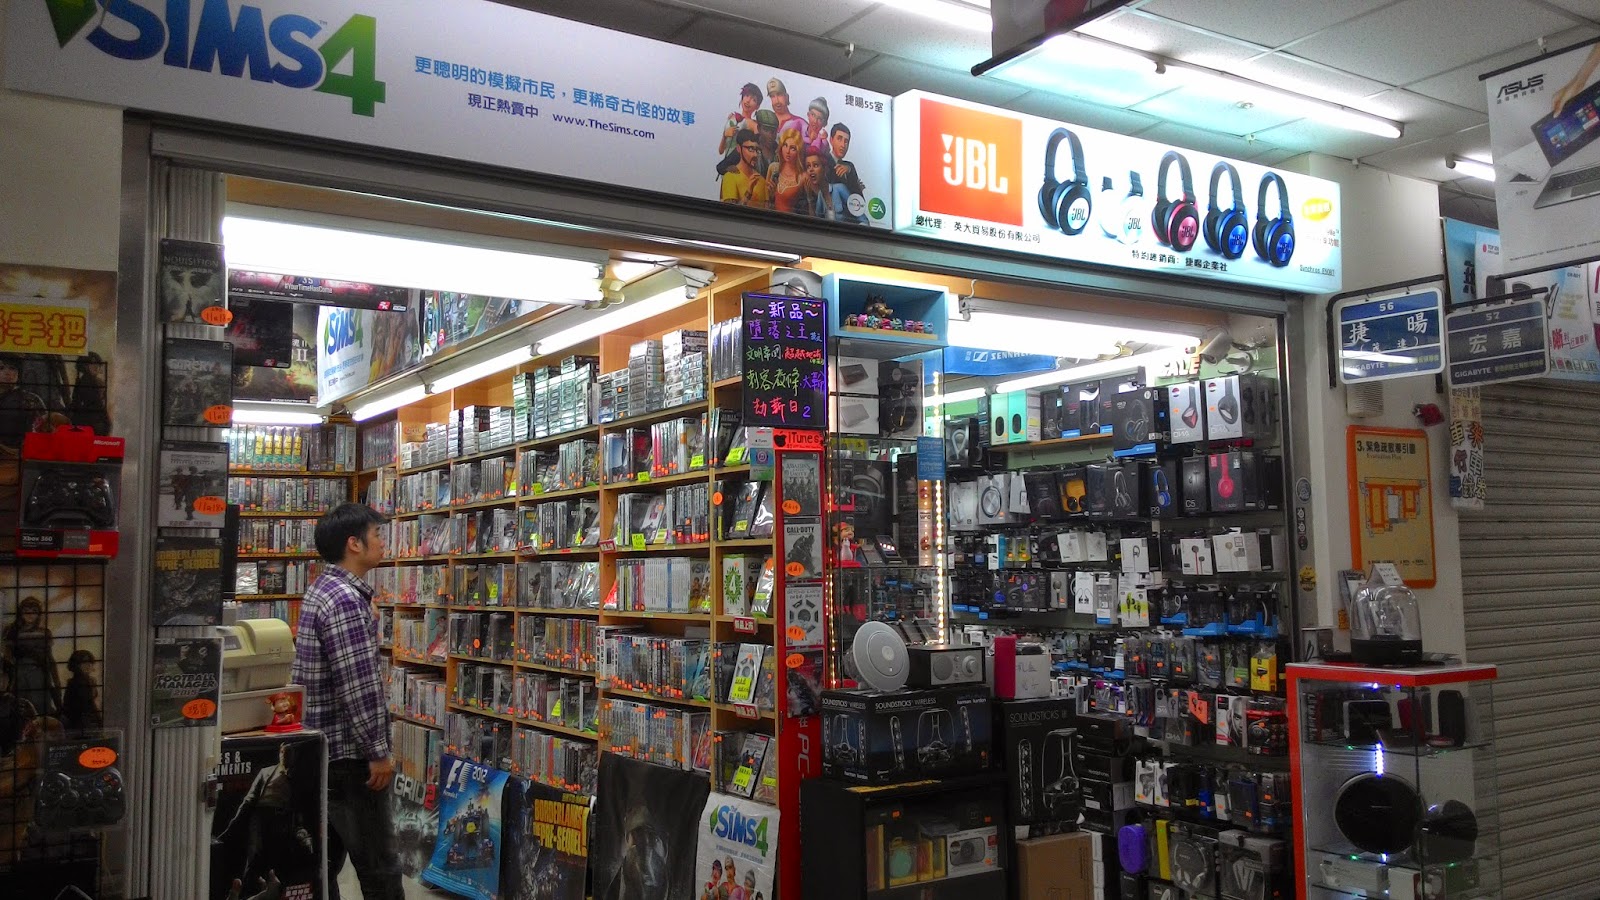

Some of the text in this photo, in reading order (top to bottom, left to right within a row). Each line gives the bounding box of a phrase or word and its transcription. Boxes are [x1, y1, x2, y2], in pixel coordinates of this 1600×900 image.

[86, 0, 386, 118] SIMS 4
[1497, 74, 1544, 99] ASUS
[552, 112, 656, 140] www.TheSims.com
[941, 132, 1009, 195] JBL
[1071, 206, 1086, 222] JBL
[1128, 217, 1142, 230] JBL
[1181, 226, 1195, 239] JBL
[1379, 301, 1395, 312] 56
[1485, 311, 1500, 321] 57
[0, 309, 87, 348] 手把
[1468, 327, 1522, 355] 宏嘉
[1454, 366, 1492, 378] GIGABYTE
[802, 405, 811, 418] 2
[154, 680, 218, 690] MANAGER
[156, 672, 216, 682] FOOTBALL
[1010, 709, 1060, 723] SOUNDSTICKS
[472, 766, 488, 784] 2012
[394, 773, 427, 805] GRID
[716, 805, 758, 848] SIMS
[755, 817, 769, 857] 4
